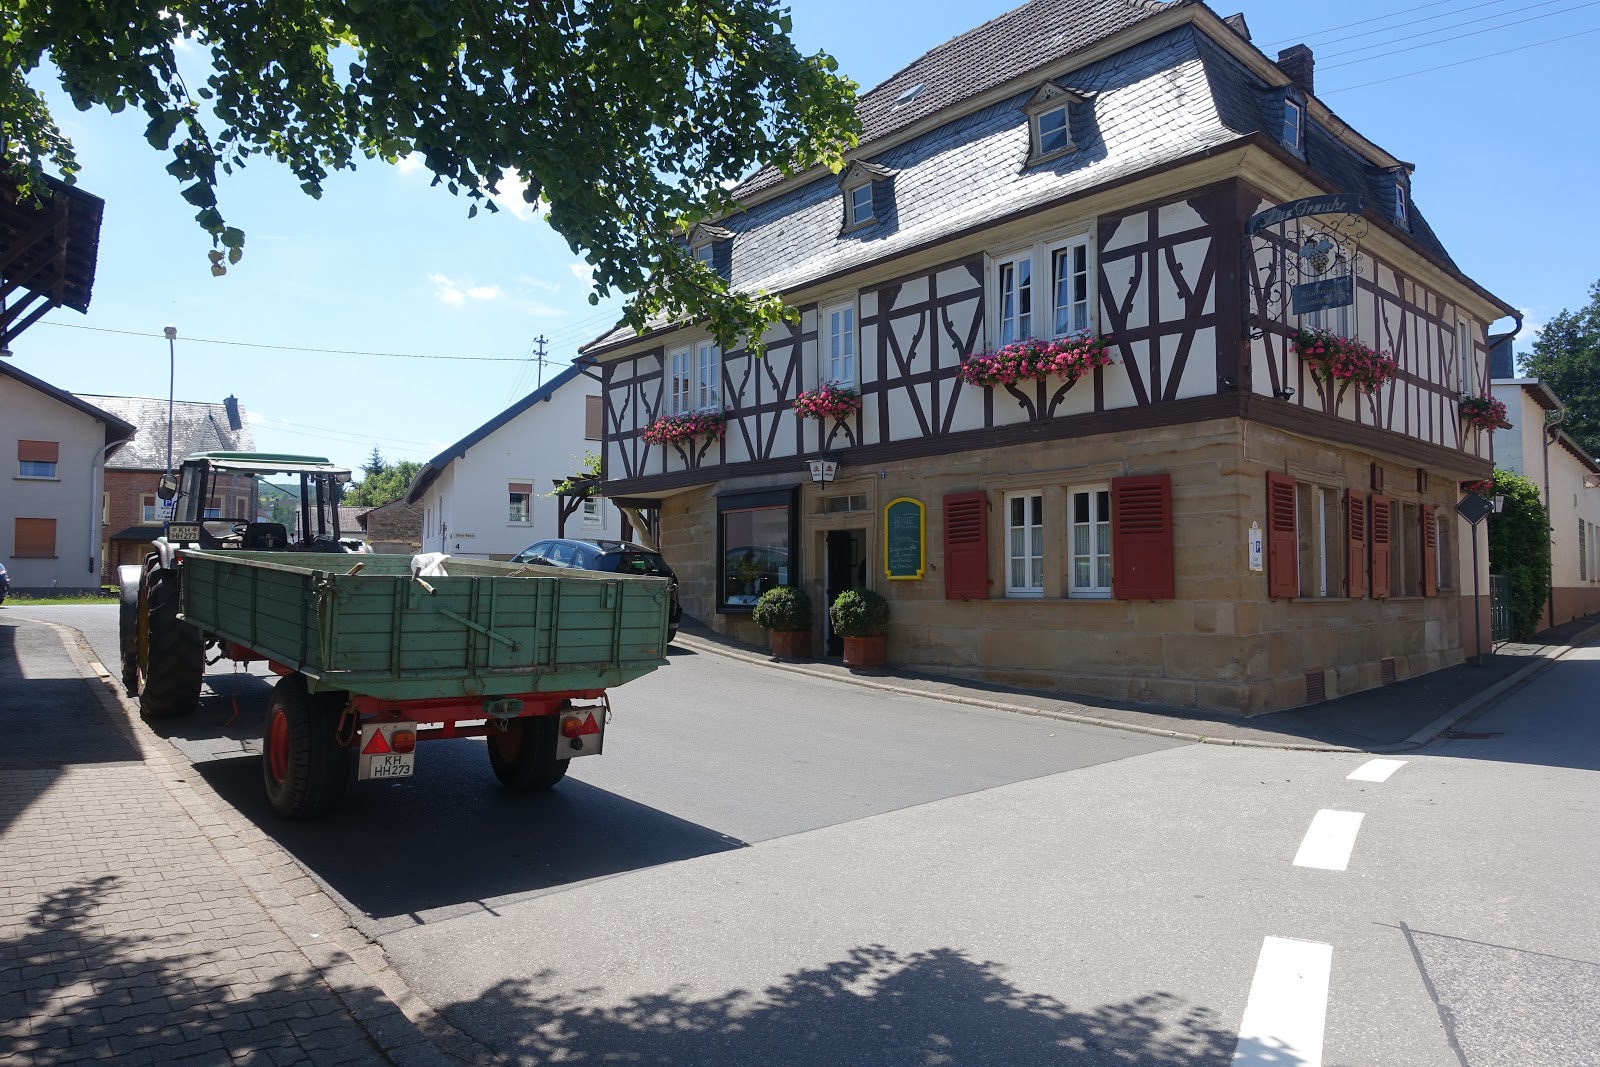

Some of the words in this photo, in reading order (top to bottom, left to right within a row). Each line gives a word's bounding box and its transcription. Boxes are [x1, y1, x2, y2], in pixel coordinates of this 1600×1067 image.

[1295, 196, 1347, 215] Traube
[172, 532, 183, 540] HH
[184, 532, 197, 540] 273
[385, 755, 402, 765] KH
